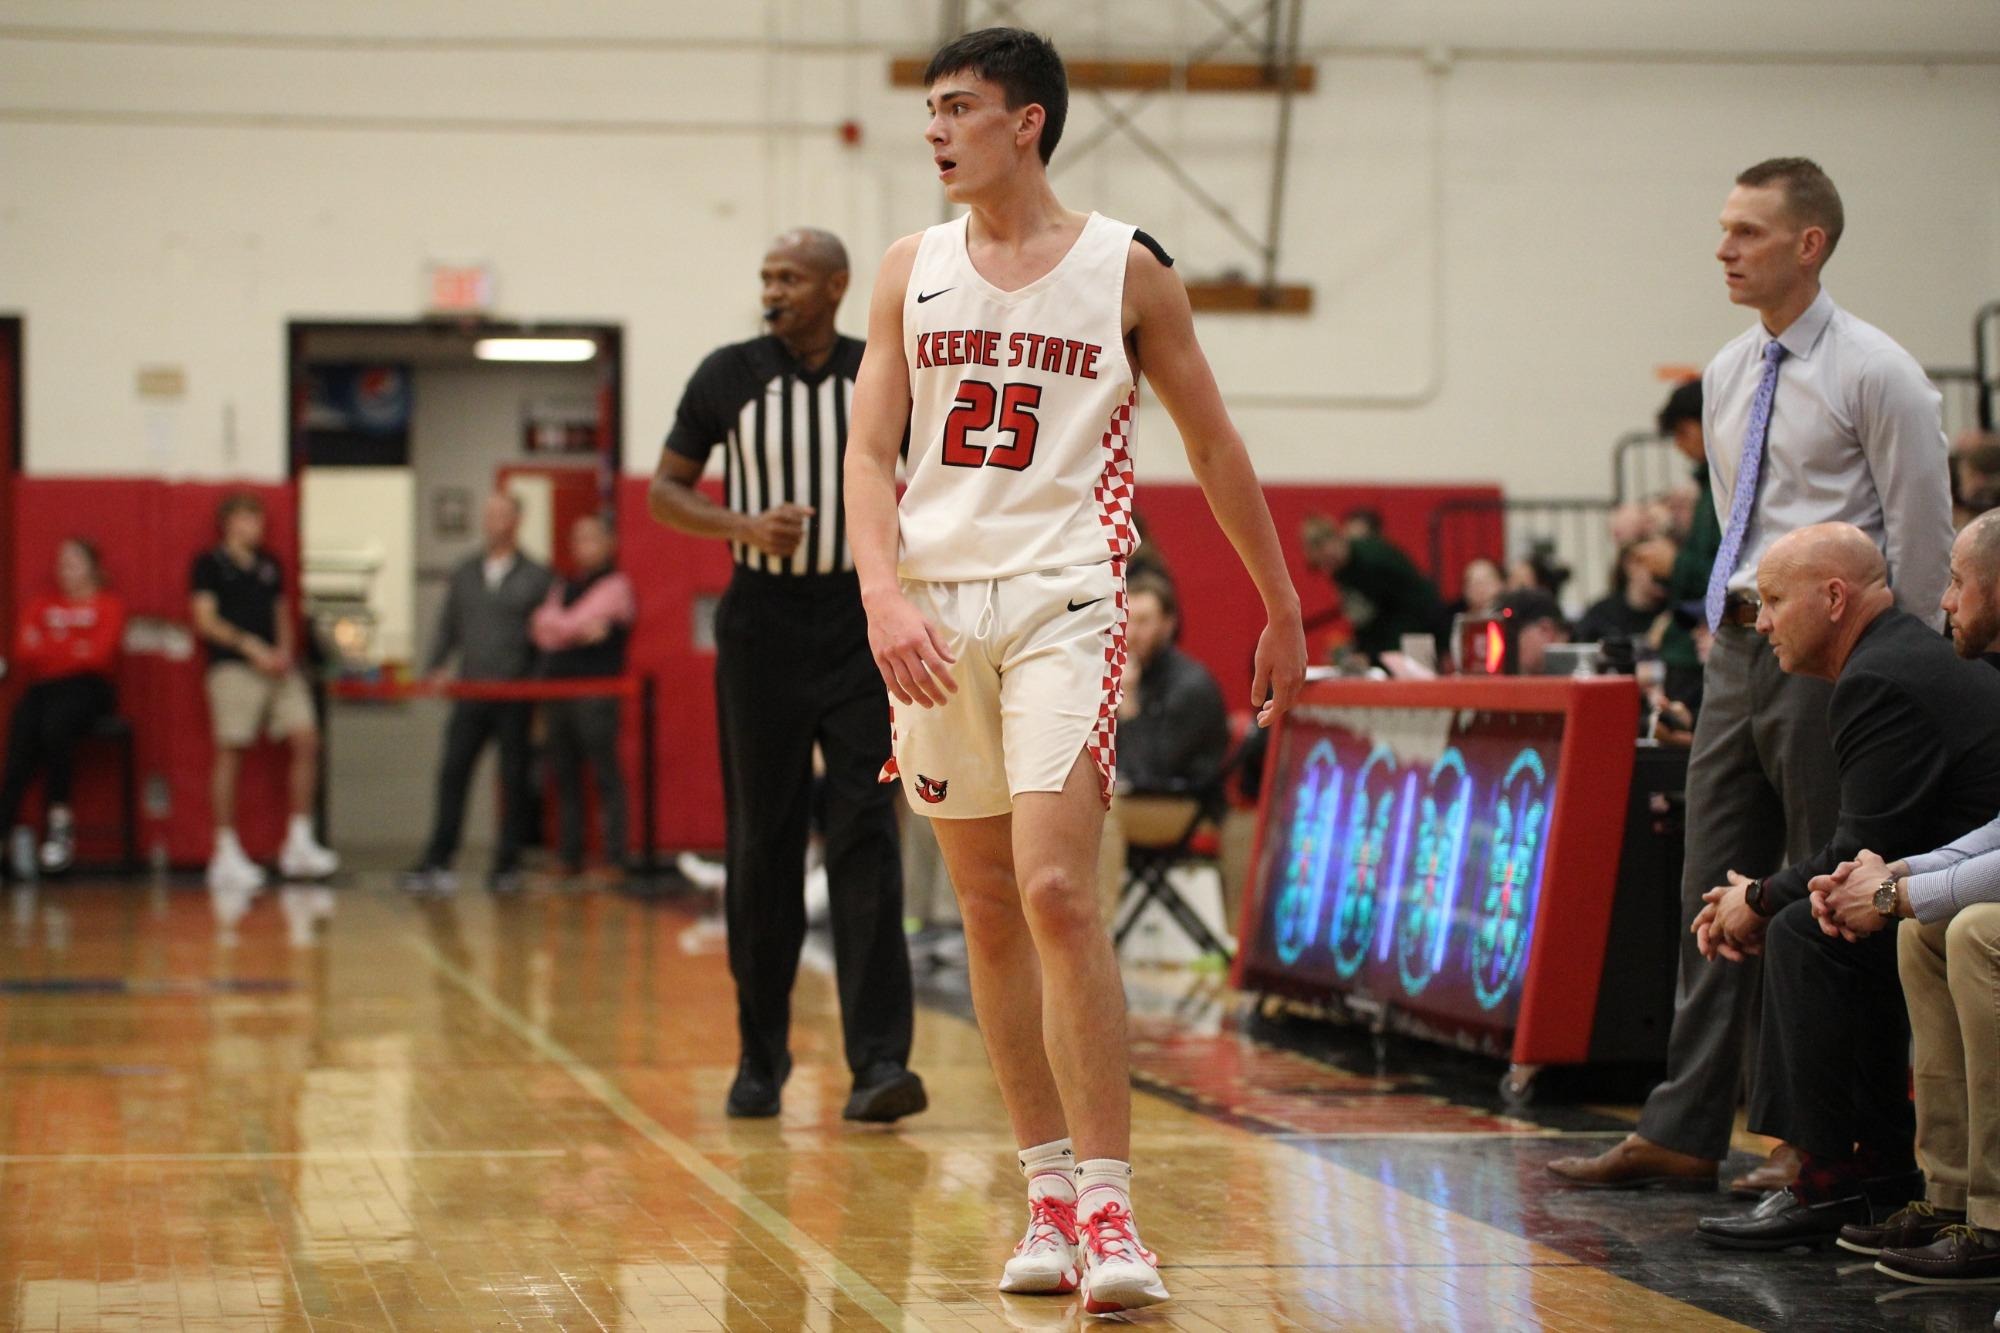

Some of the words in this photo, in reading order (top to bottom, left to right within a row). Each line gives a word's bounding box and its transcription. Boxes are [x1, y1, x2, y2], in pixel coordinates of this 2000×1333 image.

[916, 330, 1001, 369] KEENE
[1008, 332, 1102, 379] STATE
[941, 379, 1042, 472] 25
